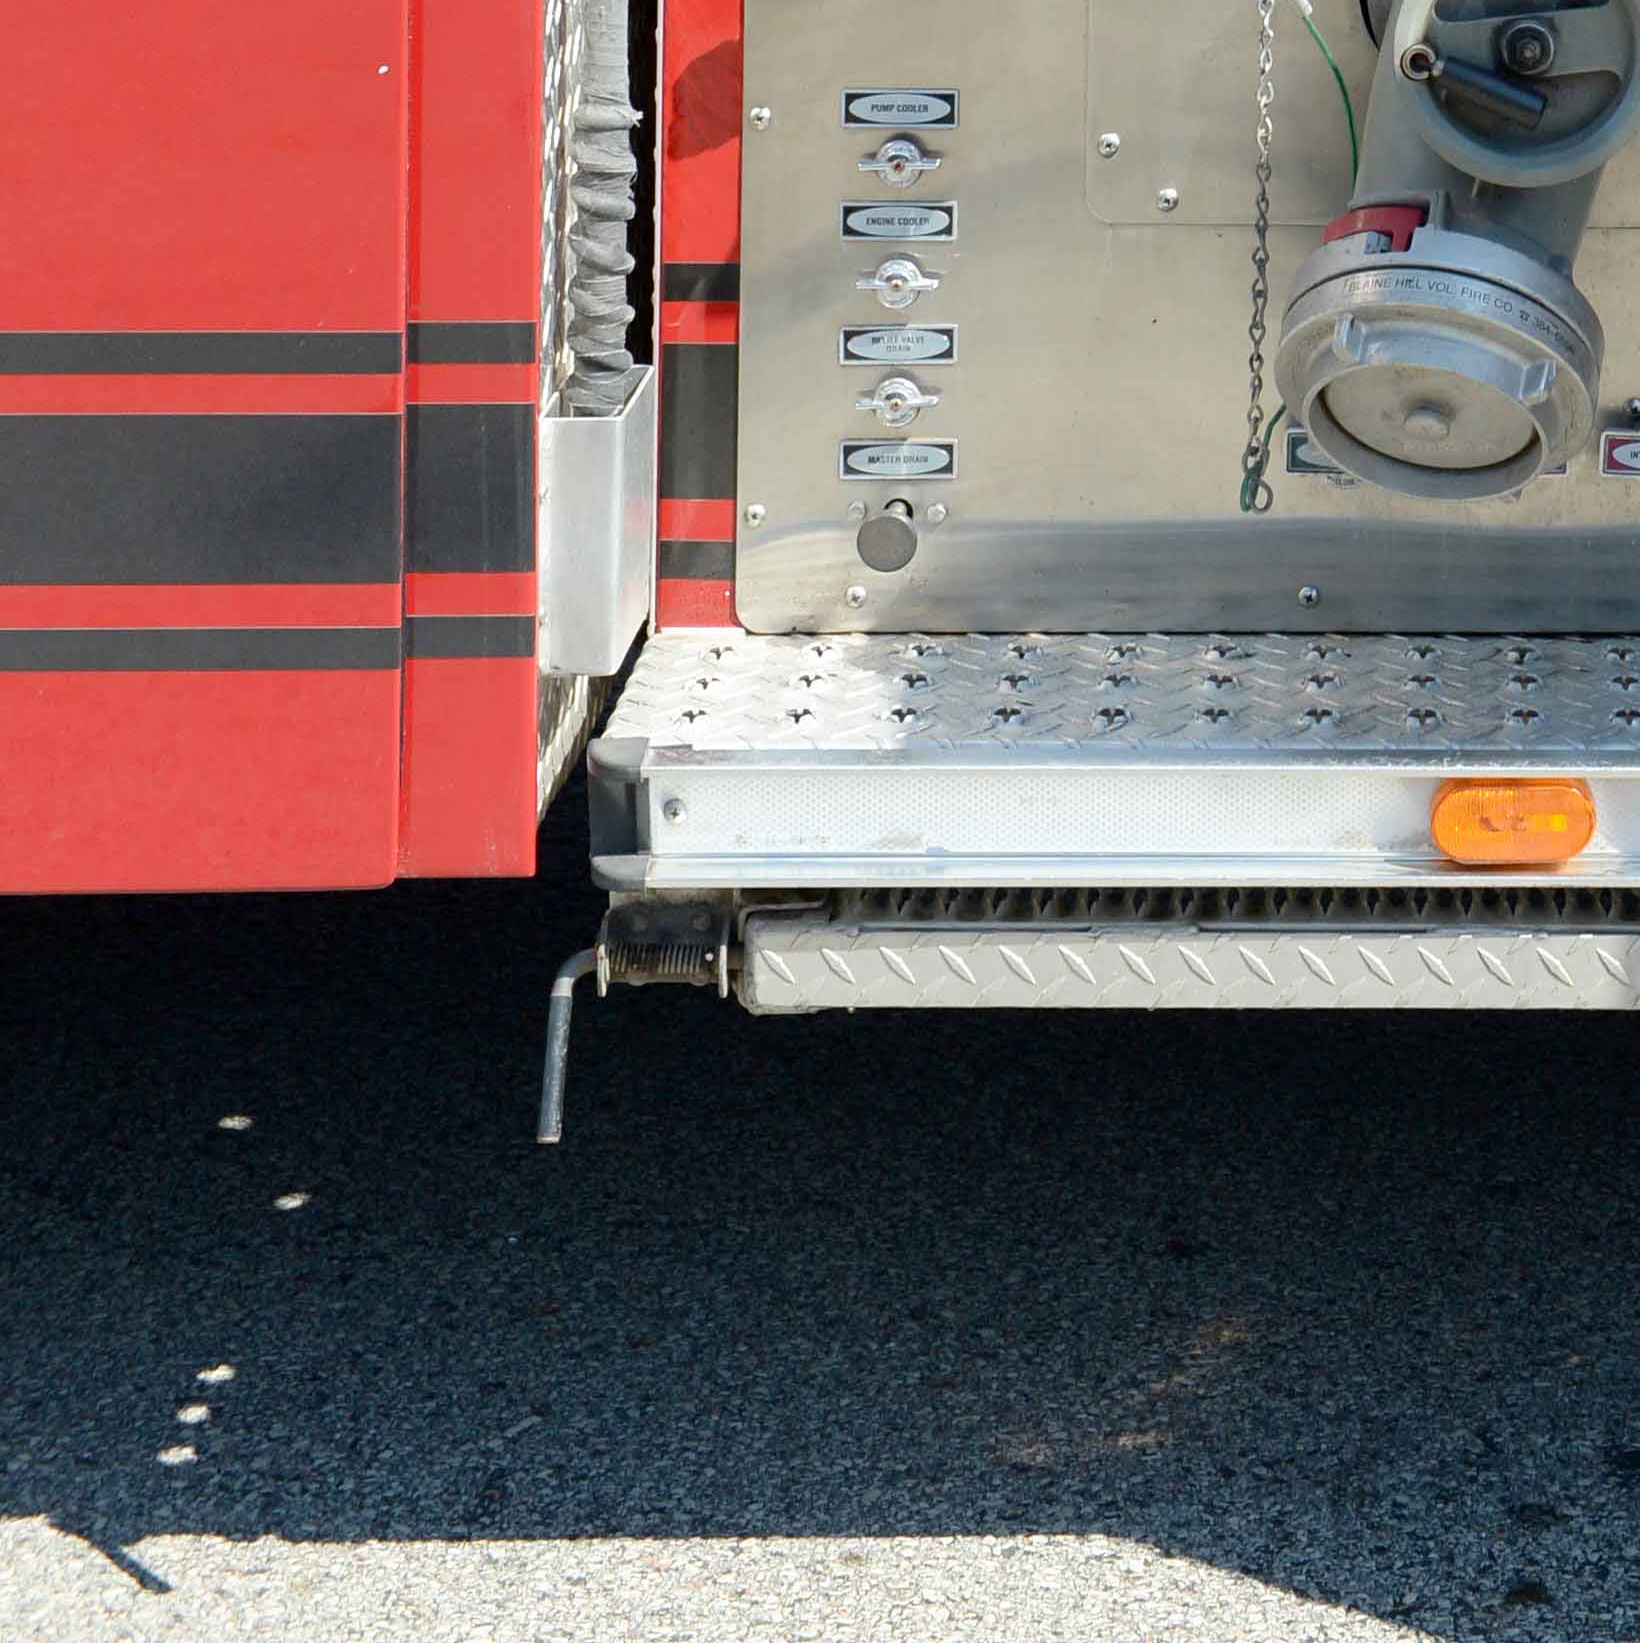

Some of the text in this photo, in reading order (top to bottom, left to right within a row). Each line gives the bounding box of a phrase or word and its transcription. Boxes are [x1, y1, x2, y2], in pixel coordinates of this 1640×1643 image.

[871, 104, 929, 113] PUMP COOLER
[866, 218, 930, 226] ENGINE COOLER
[1461, 286, 1489, 305] FIRE
[902, 336, 924, 345] VALVE
[868, 455, 929, 464] MASTER DRAIN
